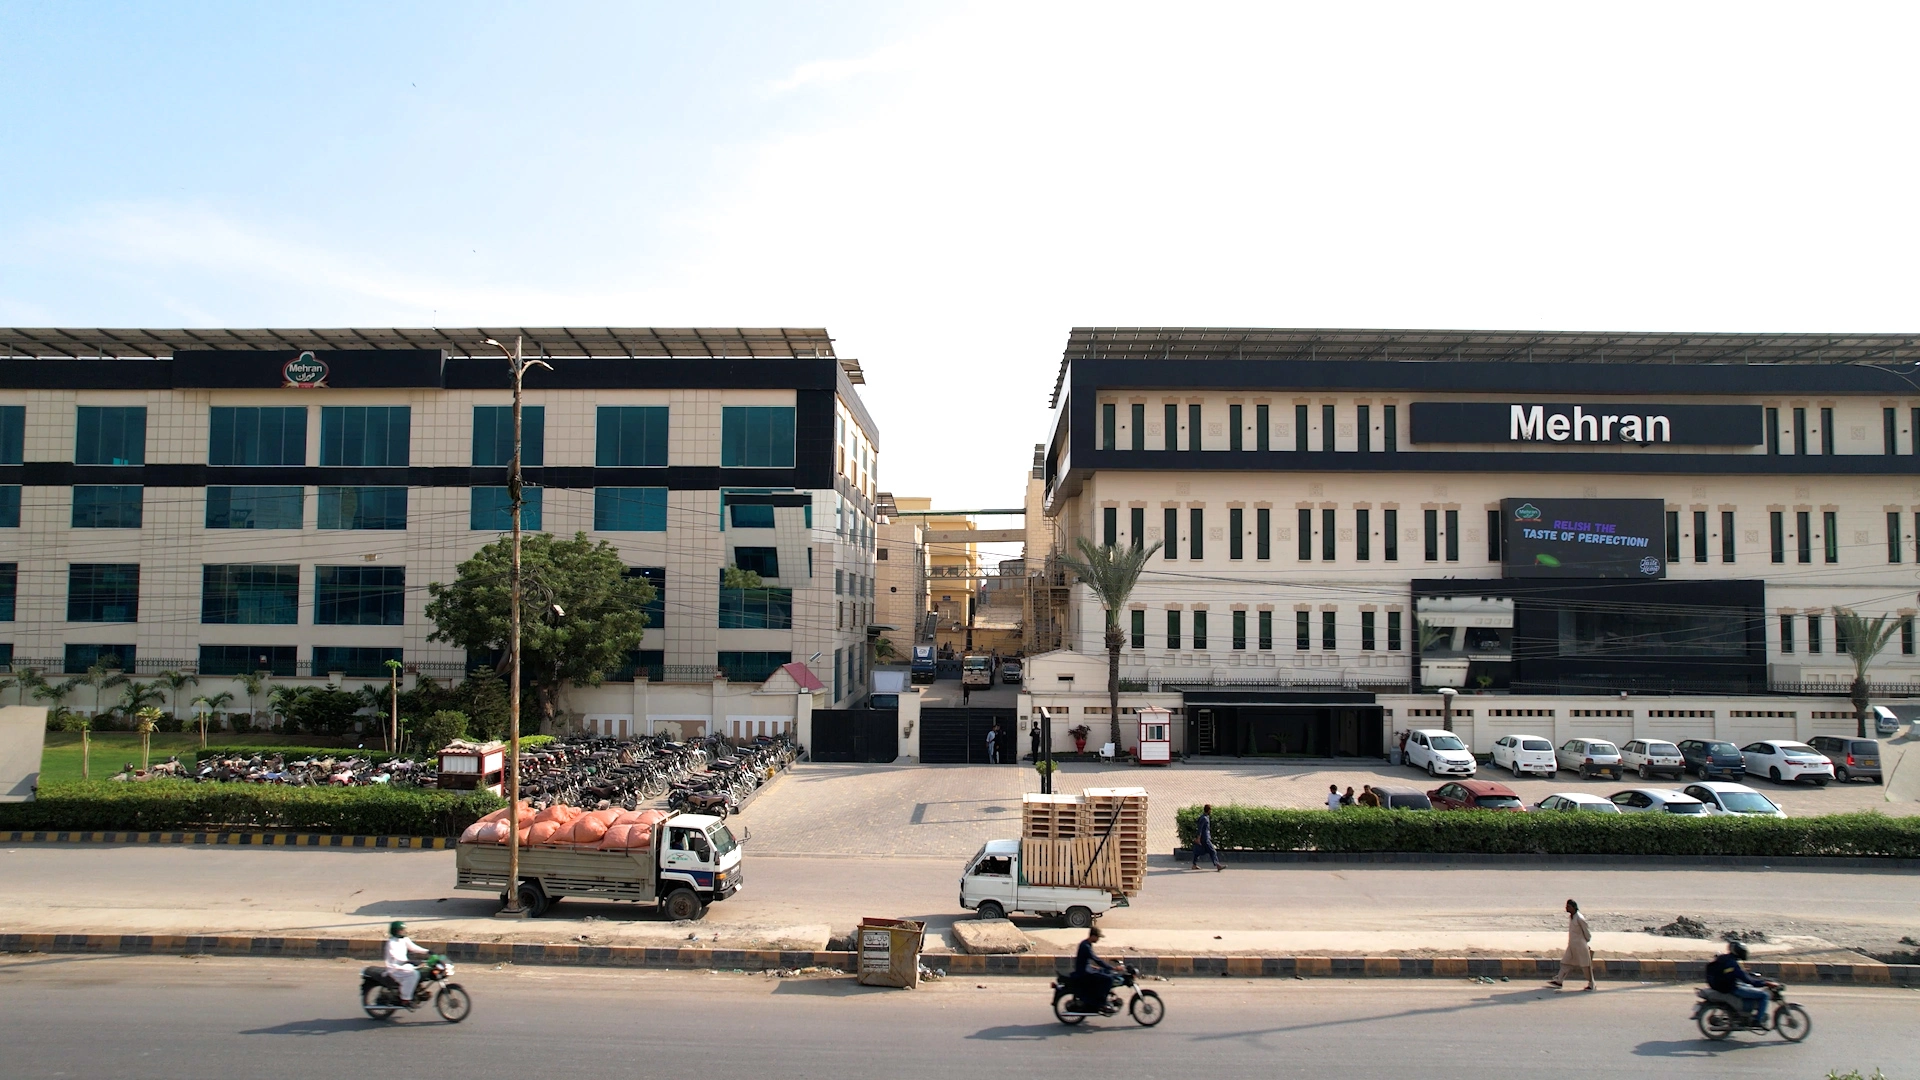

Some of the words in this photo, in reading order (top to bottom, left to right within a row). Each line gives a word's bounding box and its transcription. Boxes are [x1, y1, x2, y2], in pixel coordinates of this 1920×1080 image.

[289, 364, 322, 372] Mehran
[1510, 405, 1671, 442] Mehran
[1553, 520, 1591, 532] RELISH
[1594, 523, 1617, 534] THE
[1523, 528, 1557, 540] TASTE
[1561, 531, 1575, 542] OF
[1578, 533, 1649, 547] PERFECTION!
